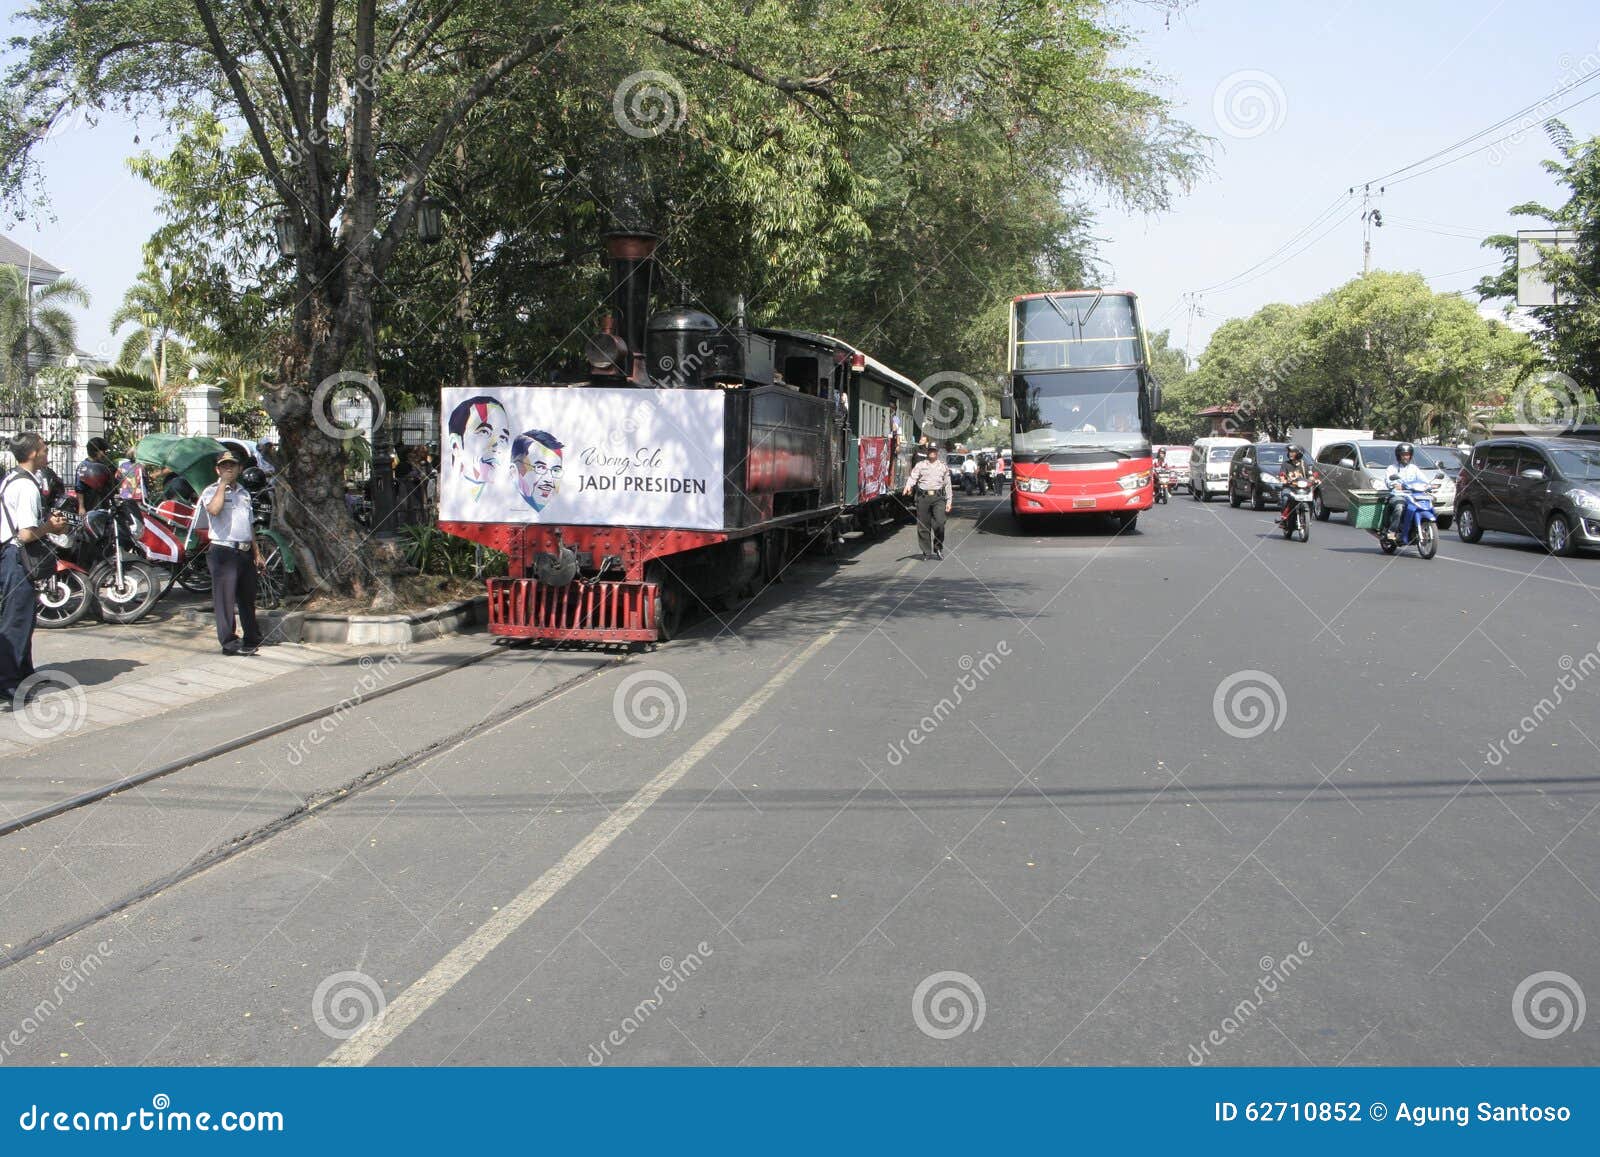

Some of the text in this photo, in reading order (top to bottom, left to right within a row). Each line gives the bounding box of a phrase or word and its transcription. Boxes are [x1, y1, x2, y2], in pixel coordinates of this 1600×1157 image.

[580, 446, 630, 476] Wong
[578, 475, 706, 495] JADI PRESIDEN
